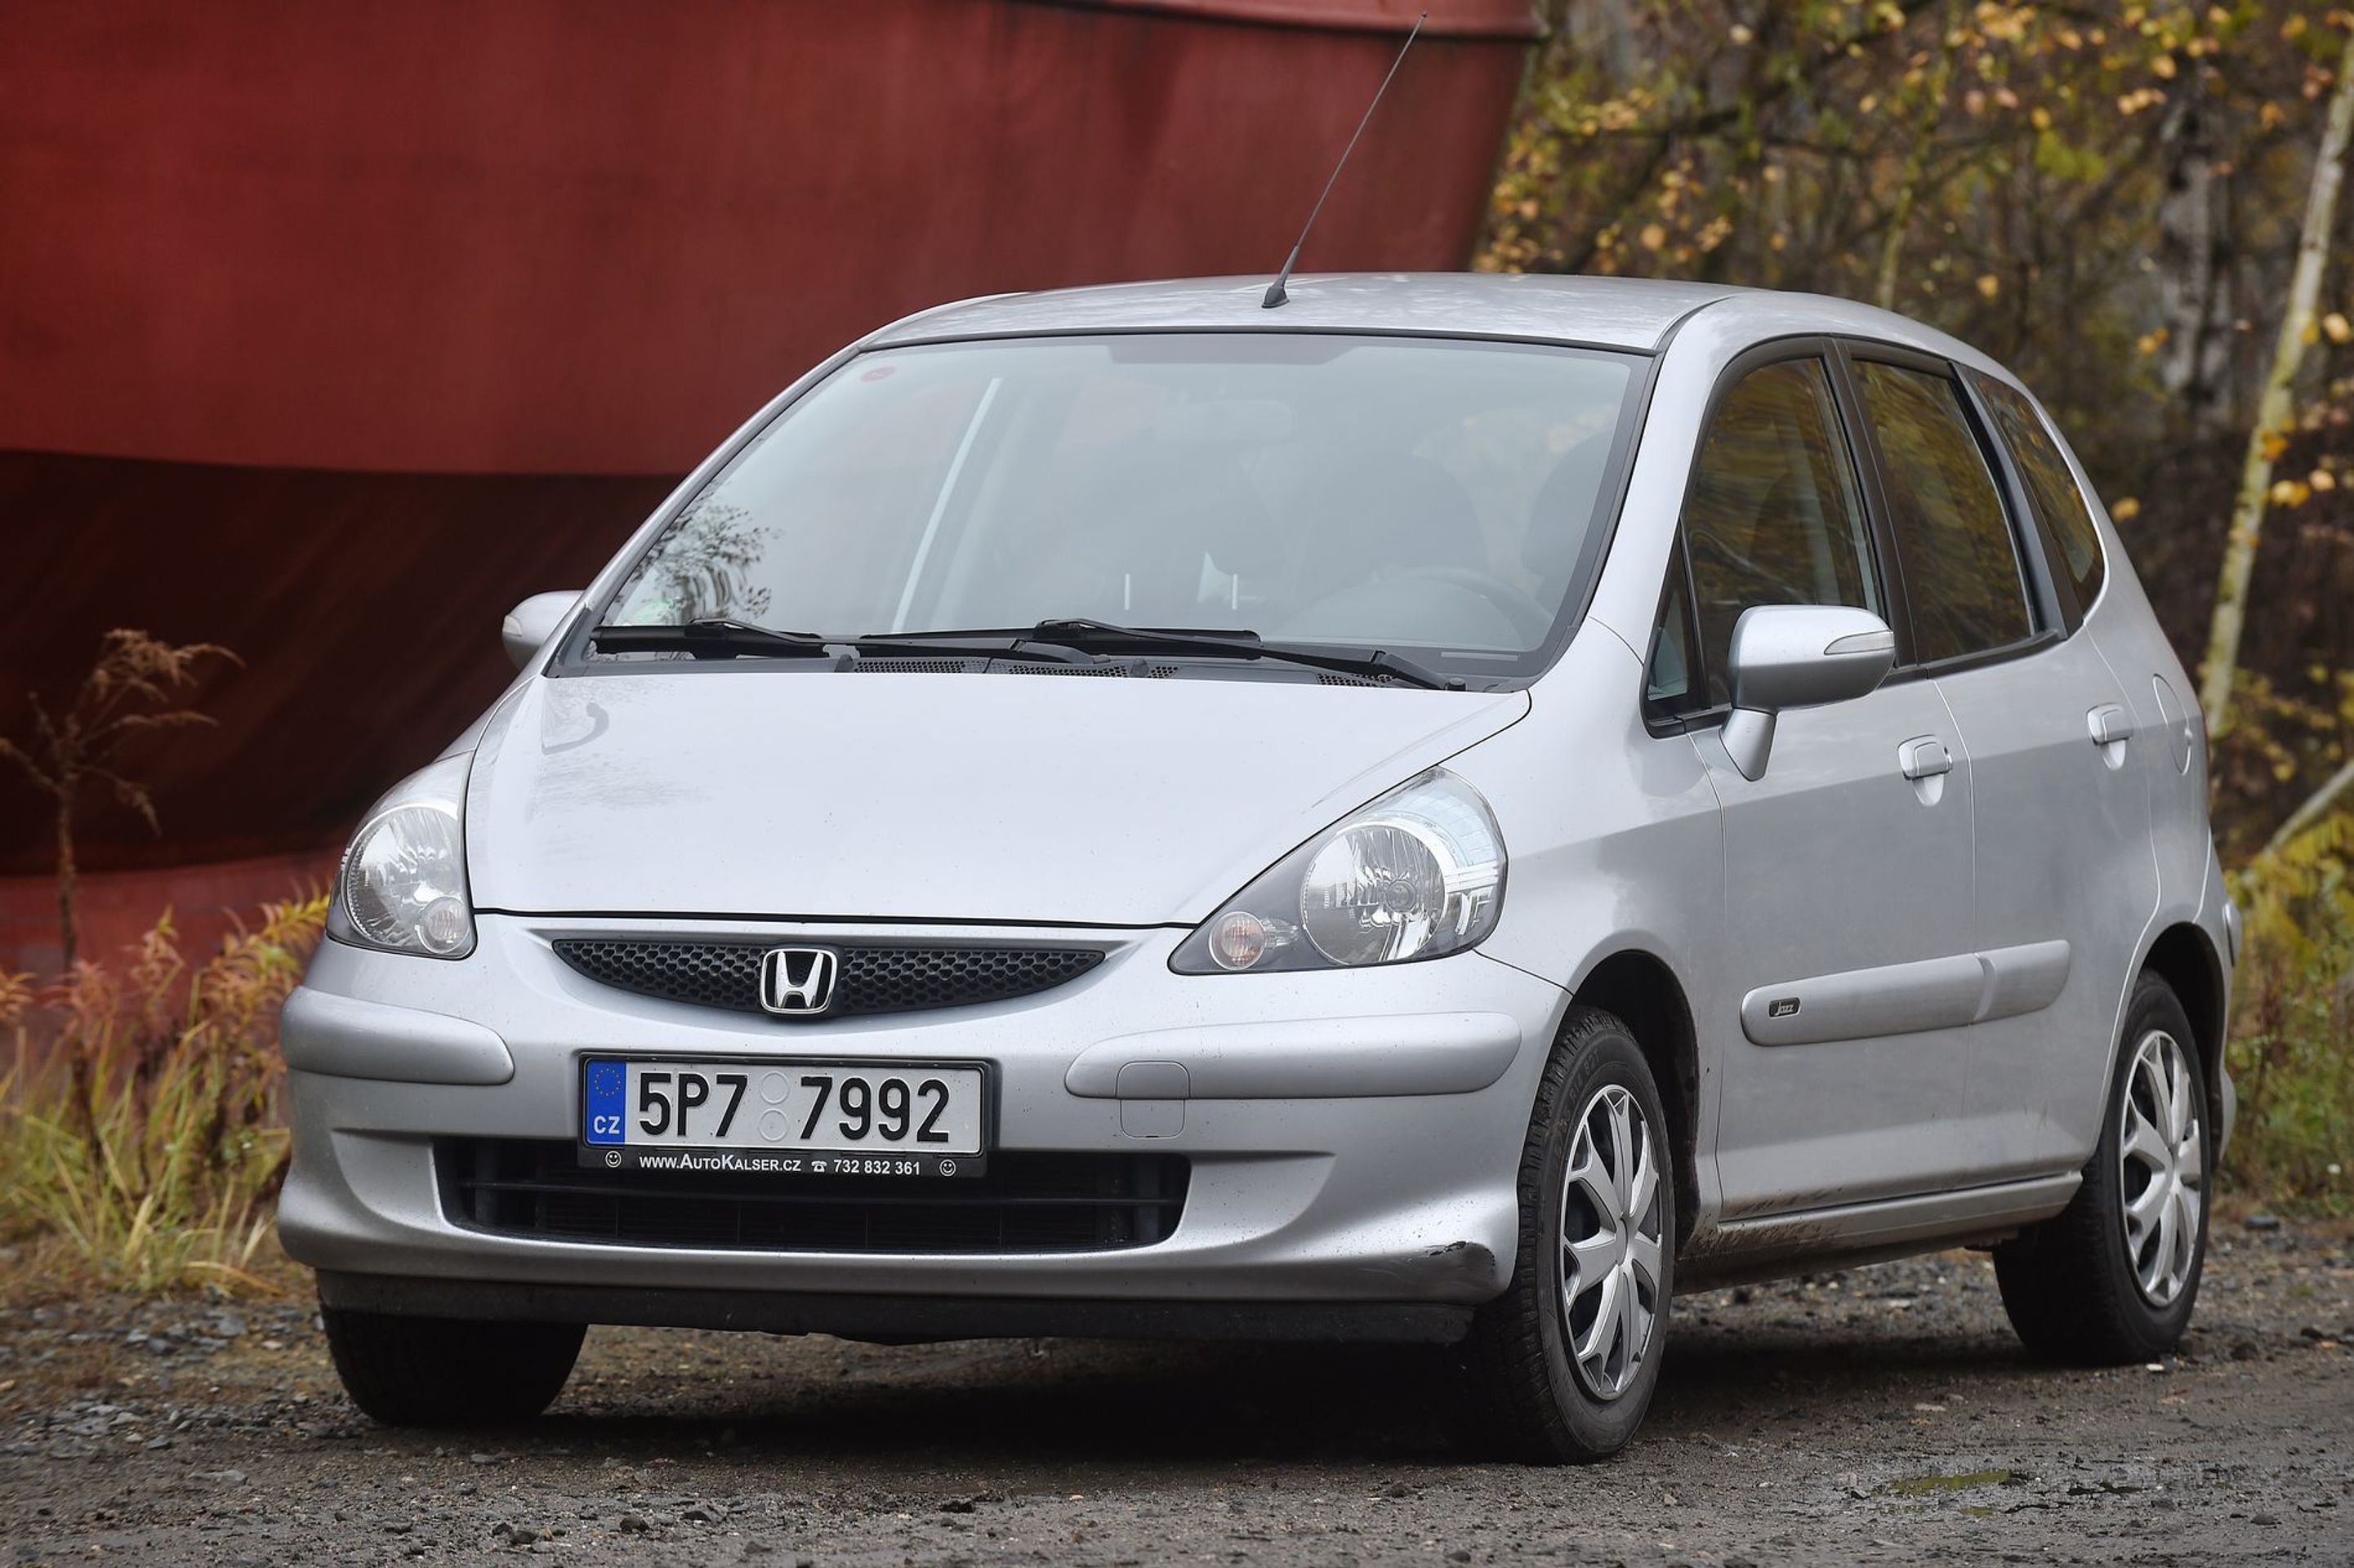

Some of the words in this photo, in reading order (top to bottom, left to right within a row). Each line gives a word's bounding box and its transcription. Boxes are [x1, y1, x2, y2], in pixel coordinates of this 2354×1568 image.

[639, 1073, 748, 1137] 5P7
[800, 1076, 949, 1143] 7992
[594, 1116, 620, 1134] CZ
[834, 1160, 860, 1174] 732
[864, 1160, 890, 1174] 832
[895, 1161, 921, 1175] 361
